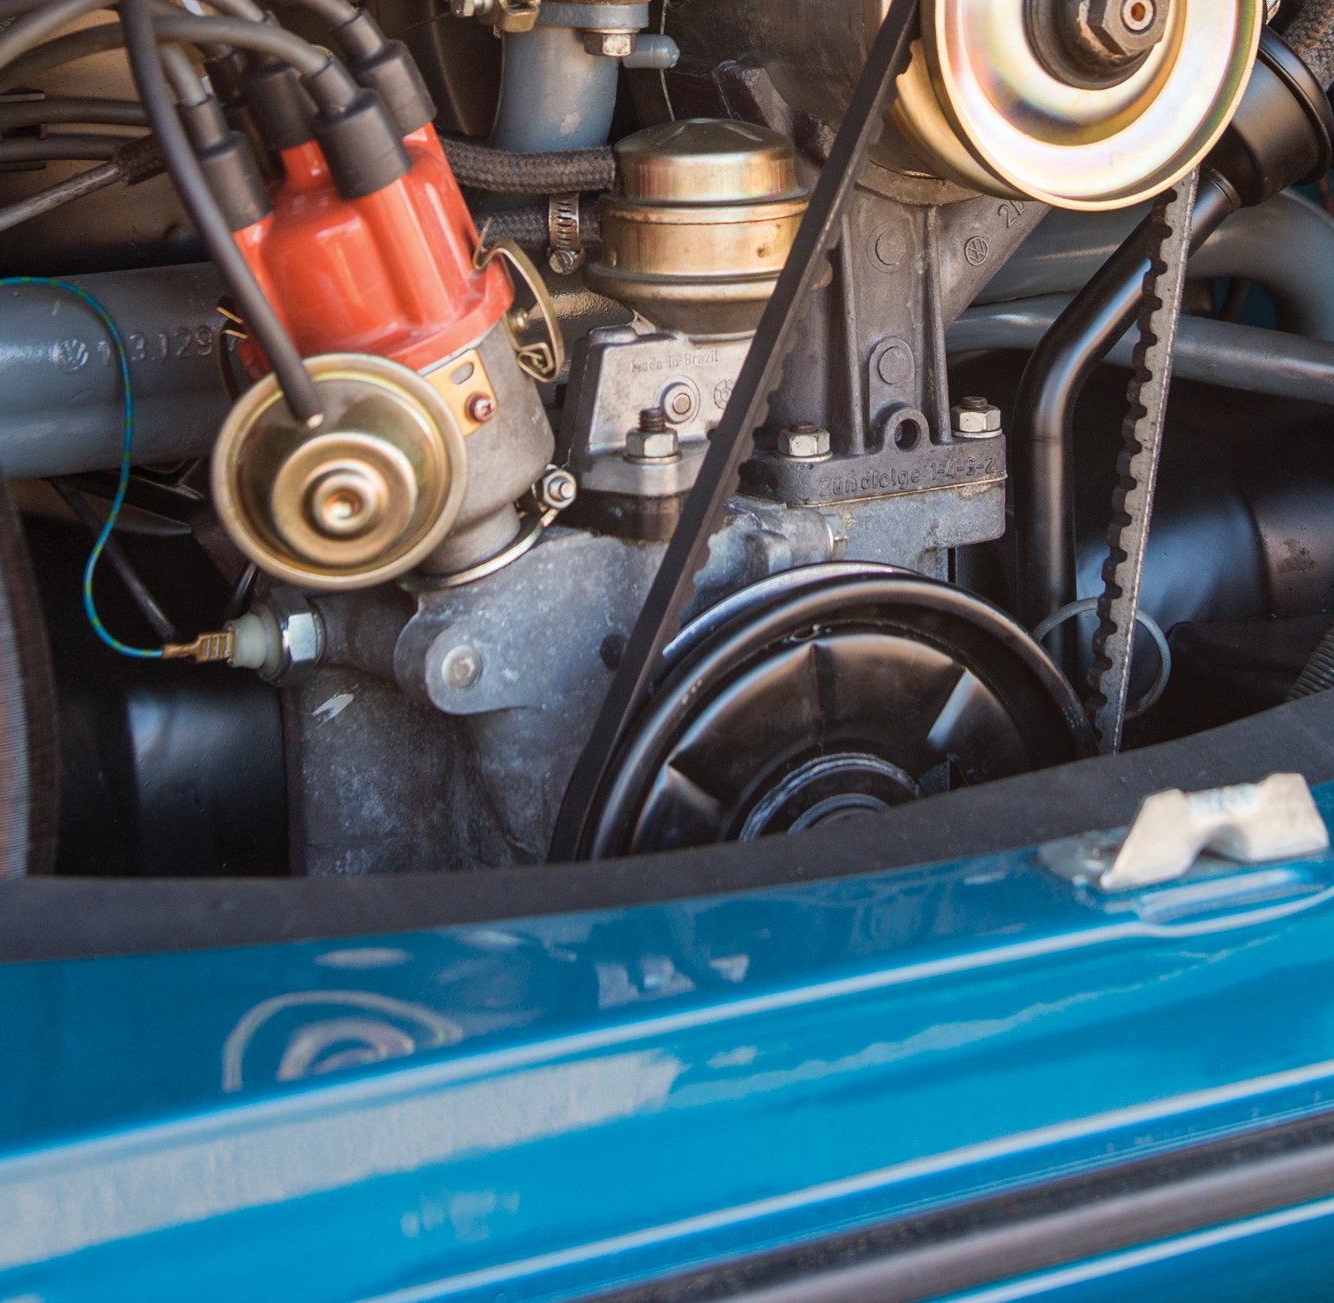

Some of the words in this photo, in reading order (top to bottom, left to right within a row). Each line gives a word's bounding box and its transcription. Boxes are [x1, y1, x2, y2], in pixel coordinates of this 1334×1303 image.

[685, 348, 719, 366] Brazil
[819, 467, 922, 497] Zündfolge
[930, 456, 996, 480] 1-4-3-2
